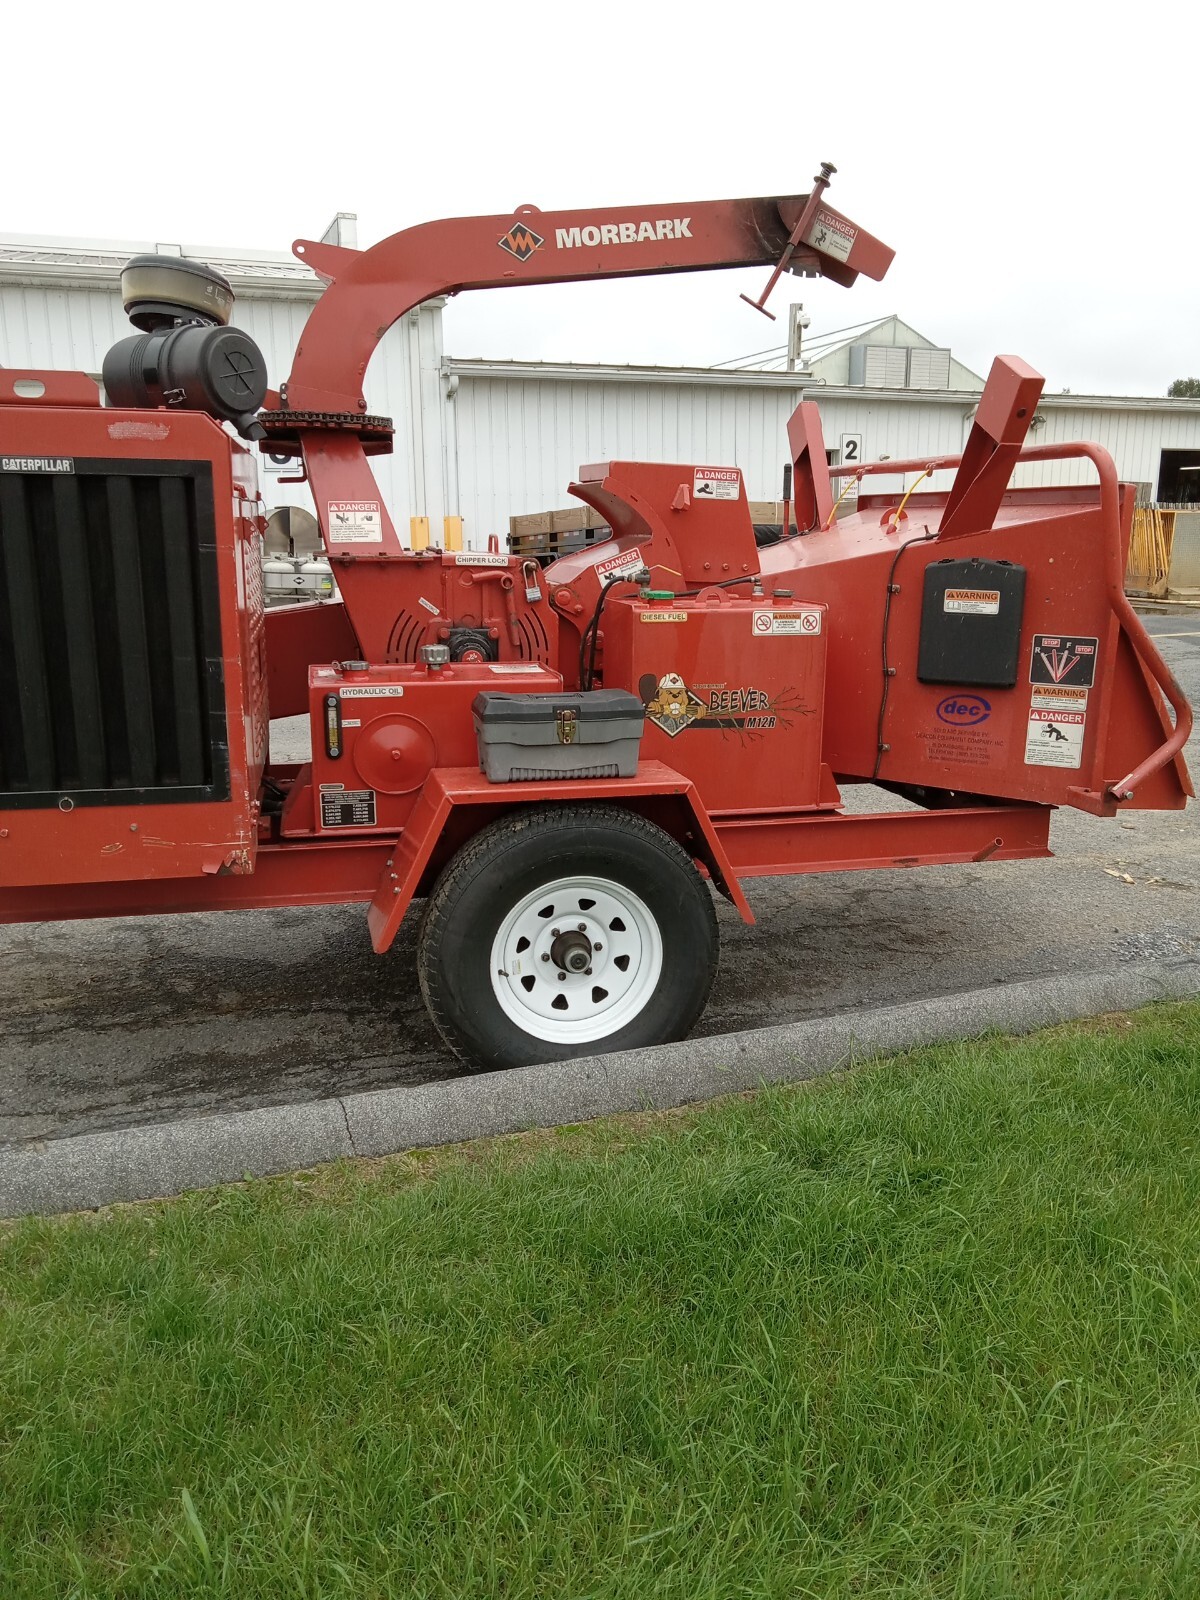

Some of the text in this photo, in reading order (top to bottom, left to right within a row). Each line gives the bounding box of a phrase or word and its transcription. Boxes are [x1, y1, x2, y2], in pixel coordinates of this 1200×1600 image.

[825, 216, 855, 237] DANGER
[555, 217, 694, 249] MORBARK
[845, 440, 858, 460] 2
[2, 458, 72, 472] CATERPILLAR
[704, 471, 738, 480] DANGER
[339, 503, 377, 511] DANGER
[605, 551, 639, 570] DANGER
[956, 591, 998, 601] WARNING
[642, 612, 686, 621] DIESEL FUEL
[1034, 646, 1041, 654] R
[342, 687, 401, 696] HYDRAULIC OIL
[1043, 688, 1086, 698] WARNING
[708, 687, 770, 713] BEEVER
[944, 700, 981, 716] dec
[745, 716, 777, 729] M12R
[1041, 712, 1082, 723] DANGER
